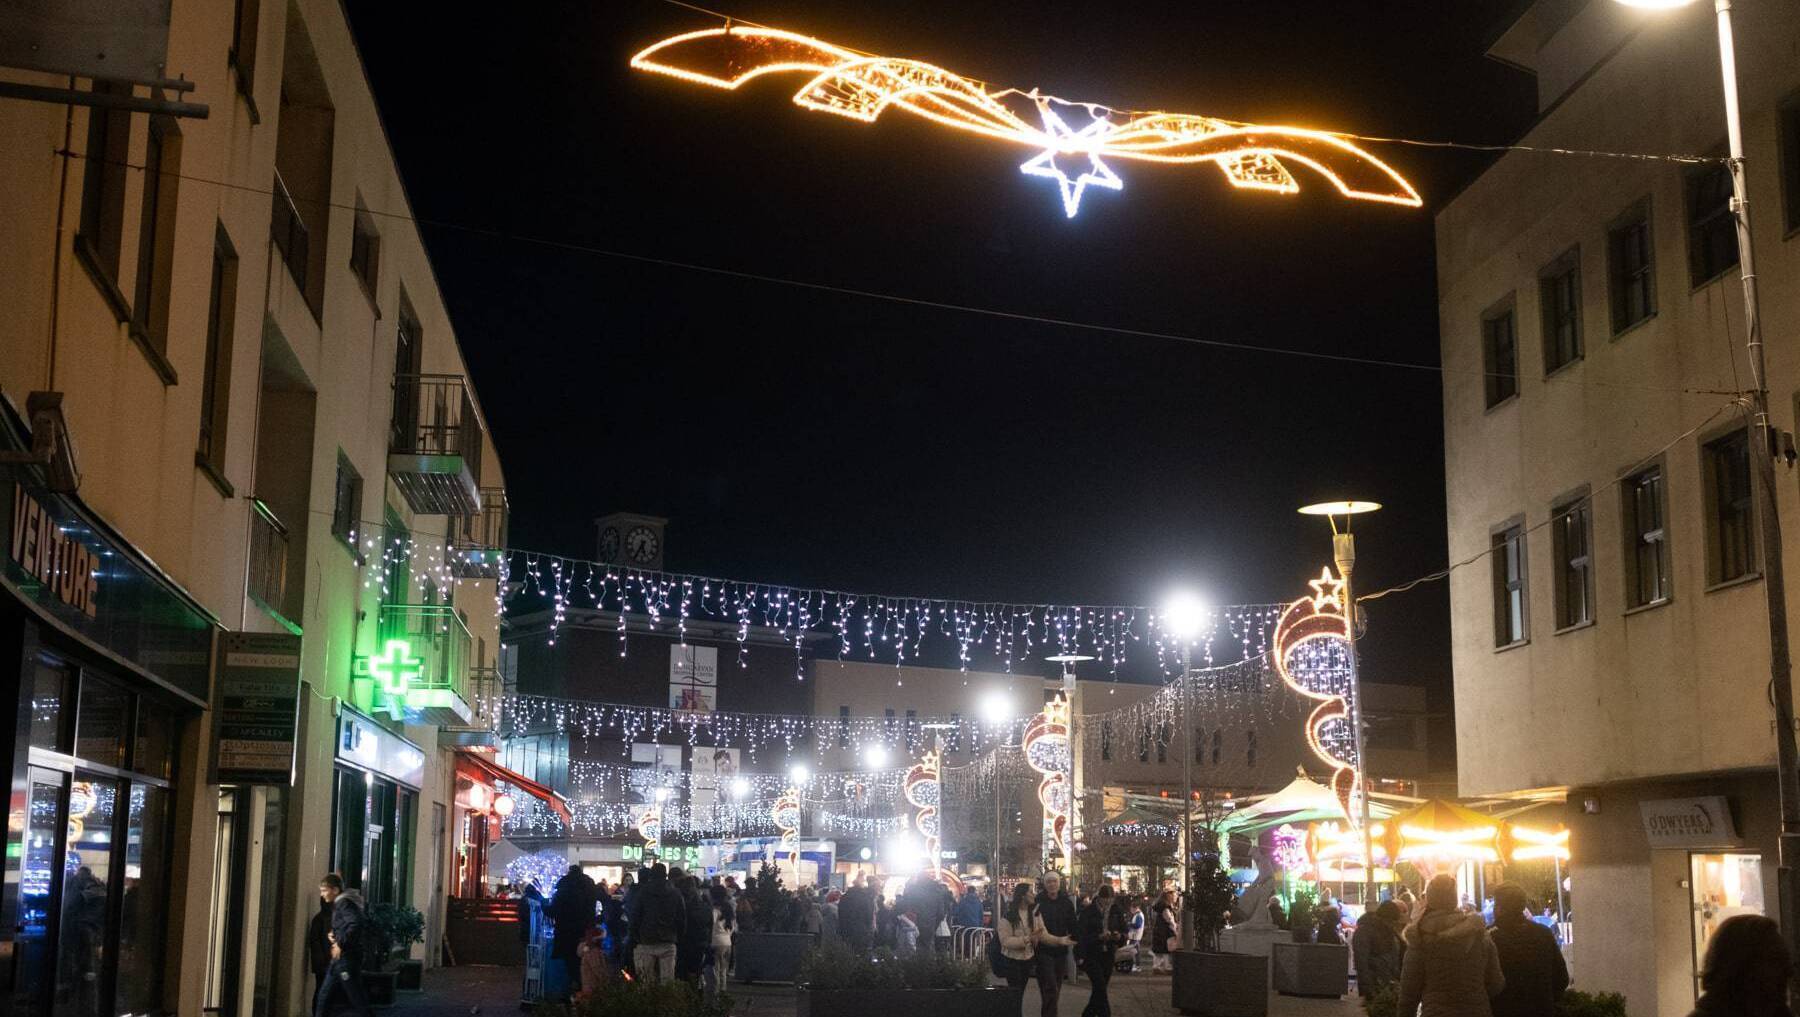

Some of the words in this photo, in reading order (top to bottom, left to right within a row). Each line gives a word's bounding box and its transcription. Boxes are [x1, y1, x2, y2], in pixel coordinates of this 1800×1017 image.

[12, 481, 99, 617] VENTURE
[1649, 813, 1704, 830] O'DWYERS
[622, 846, 682, 860] DUES
